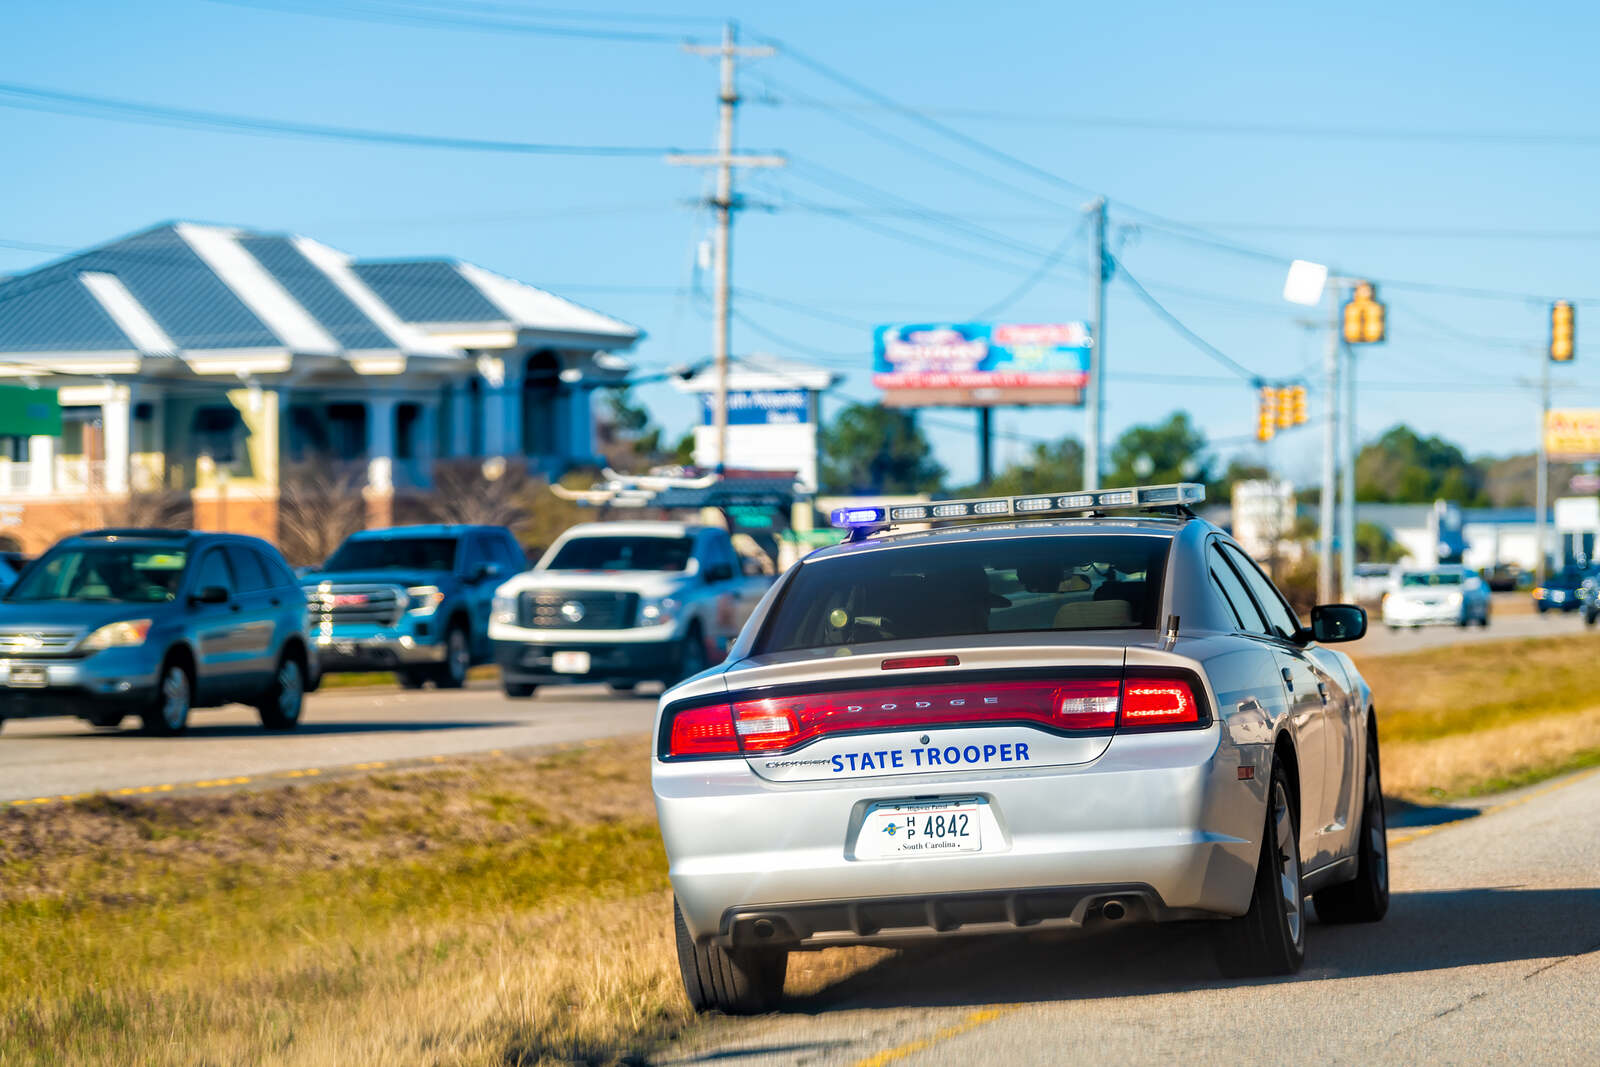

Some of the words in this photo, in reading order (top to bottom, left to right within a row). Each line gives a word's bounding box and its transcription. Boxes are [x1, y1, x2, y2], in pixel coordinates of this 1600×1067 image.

[847, 697, 998, 713] DODGE
[832, 750, 904, 773] STATE
[911, 742, 1030, 769] TROOPER
[923, 813, 970, 839] 4842
[902, 842, 924, 851] South
[925, 841, 956, 850] Carolina
